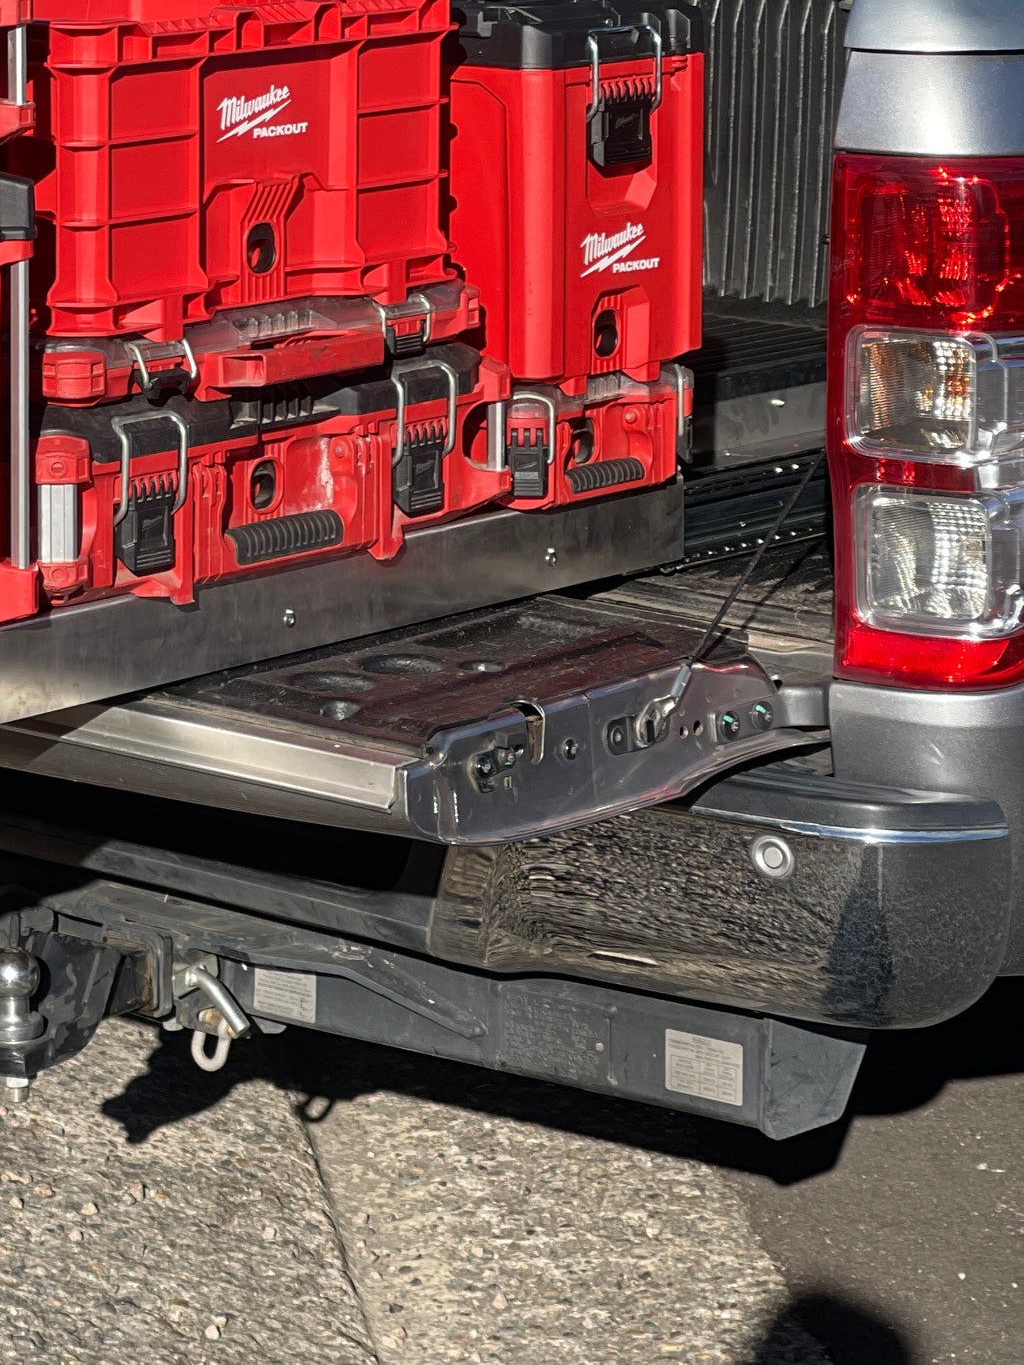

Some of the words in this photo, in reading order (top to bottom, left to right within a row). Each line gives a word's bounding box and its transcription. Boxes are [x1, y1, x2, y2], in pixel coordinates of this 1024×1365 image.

[217, 85, 290, 130] Milwaukee
[253, 122, 308, 138] PACKOUT
[580, 222, 644, 265] Milwaukee
[612, 257, 660, 273] PACKOUT
